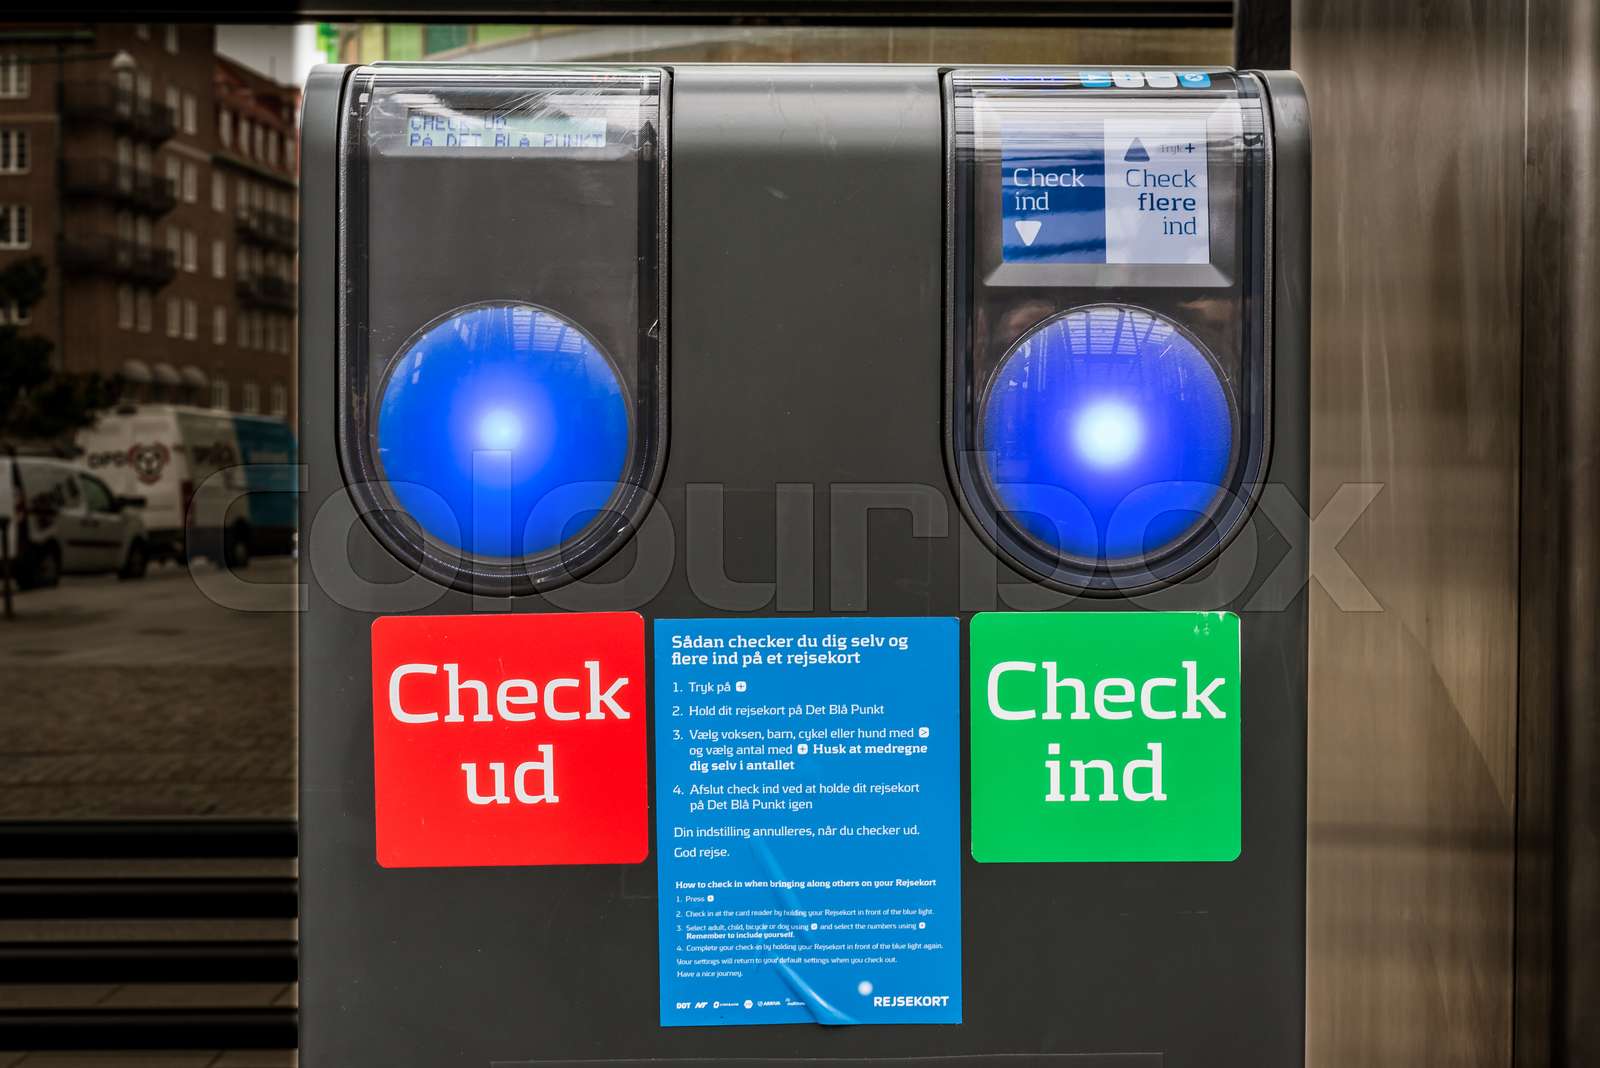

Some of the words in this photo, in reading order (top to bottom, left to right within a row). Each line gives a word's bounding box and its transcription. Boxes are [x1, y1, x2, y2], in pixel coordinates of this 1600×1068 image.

[1014, 168, 1085, 188] Check
[1126, 168, 1197, 188] Check
[1016, 192, 1050, 211] ind
[1138, 193, 1196, 211] flere
[1163, 216, 1197, 235] ind
[671, 635, 724, 648] Sådan
[728, 634, 794, 648] checker
[797, 634, 817, 647] du
[822, 634, 847, 650] dig
[851, 634, 885, 647] selv
[888, 636, 908, 650] og
[671, 651, 708, 665] flere
[712, 651, 738, 664] ind
[742, 650, 763, 667] på
[766, 652, 783, 664] et
[786, 648, 860, 667] rejsekort
[388, 660, 630, 723] Check
[673, 682, 682, 692] 1.
[688, 681, 713, 694] Tryk
[717, 682, 731, 694] på
[987, 660, 1226, 720] Check
[672, 705, 682, 716] 2.
[689, 705, 715, 716] Hold
[718, 705, 732, 715] dit
[735, 705, 785, 717] rejsekort
[788, 704, 802, 717] på
[805, 704, 825, 714] Det
[829, 704, 848, 714] Blå
[851, 704, 884, 714] Punkt
[673, 729, 683, 740] 3.
[689, 729, 719, 742] Vælg
[721, 729, 765, 740] voksen,
[767, 728, 796, 740] barn,
[798, 728, 828, 741] cykel
[830, 728, 855, 738] eller
[857, 727, 886, 738] hund
[889, 727, 914, 738] med
[688, 747, 704, 758] og
[705, 744, 734, 757] vælg
[735, 744, 765, 754] antal
[767, 744, 793, 754] med
[812, 743, 847, 754] Husk
[848, 744, 862, 754] at
[864, 743, 928, 756] medregne
[689, 760, 709, 773] dig
[709, 760, 737, 771] selv
[739, 760, 744, 770] i
[745, 759, 796, 770] antallet
[1045, 742, 1167, 802] ind
[461, 744, 560, 805] ud
[672, 784, 684, 794] 4.
[689, 784, 724, 794] Afslut
[726, 783, 759, 794] check
[762, 783, 779, 794] ind
[782, 783, 802, 793] ved
[805, 784, 816, 793] at
[819, 783, 850, 793] holde
[852, 783, 867, 793] dit
[870, 782, 920, 795] rejsekort
[690, 800, 704, 812] på
[707, 799, 727, 810] Det
[731, 799, 749, 809] Blå
[752, 799, 785, 809] Punkt
[788, 801, 812, 811] igen
[674, 827, 693, 837] Din
[696, 826, 750, 838] indstilling
[752, 826, 815, 837] annulleres,
[818, 826, 837, 835] når
[839, 825, 853, 835] du
[856, 825, 900, 835] checker
[903, 824, 919, 835] ud.
[674, 847, 696, 857] God
[699, 848, 729, 859] rejse.
[806, 880, 830, 888] along
[895, 879, 936, 887] Rejsekort
[762, 931, 795, 939] yourself.
[873, 996, 950, 1008] REJSEKORT
